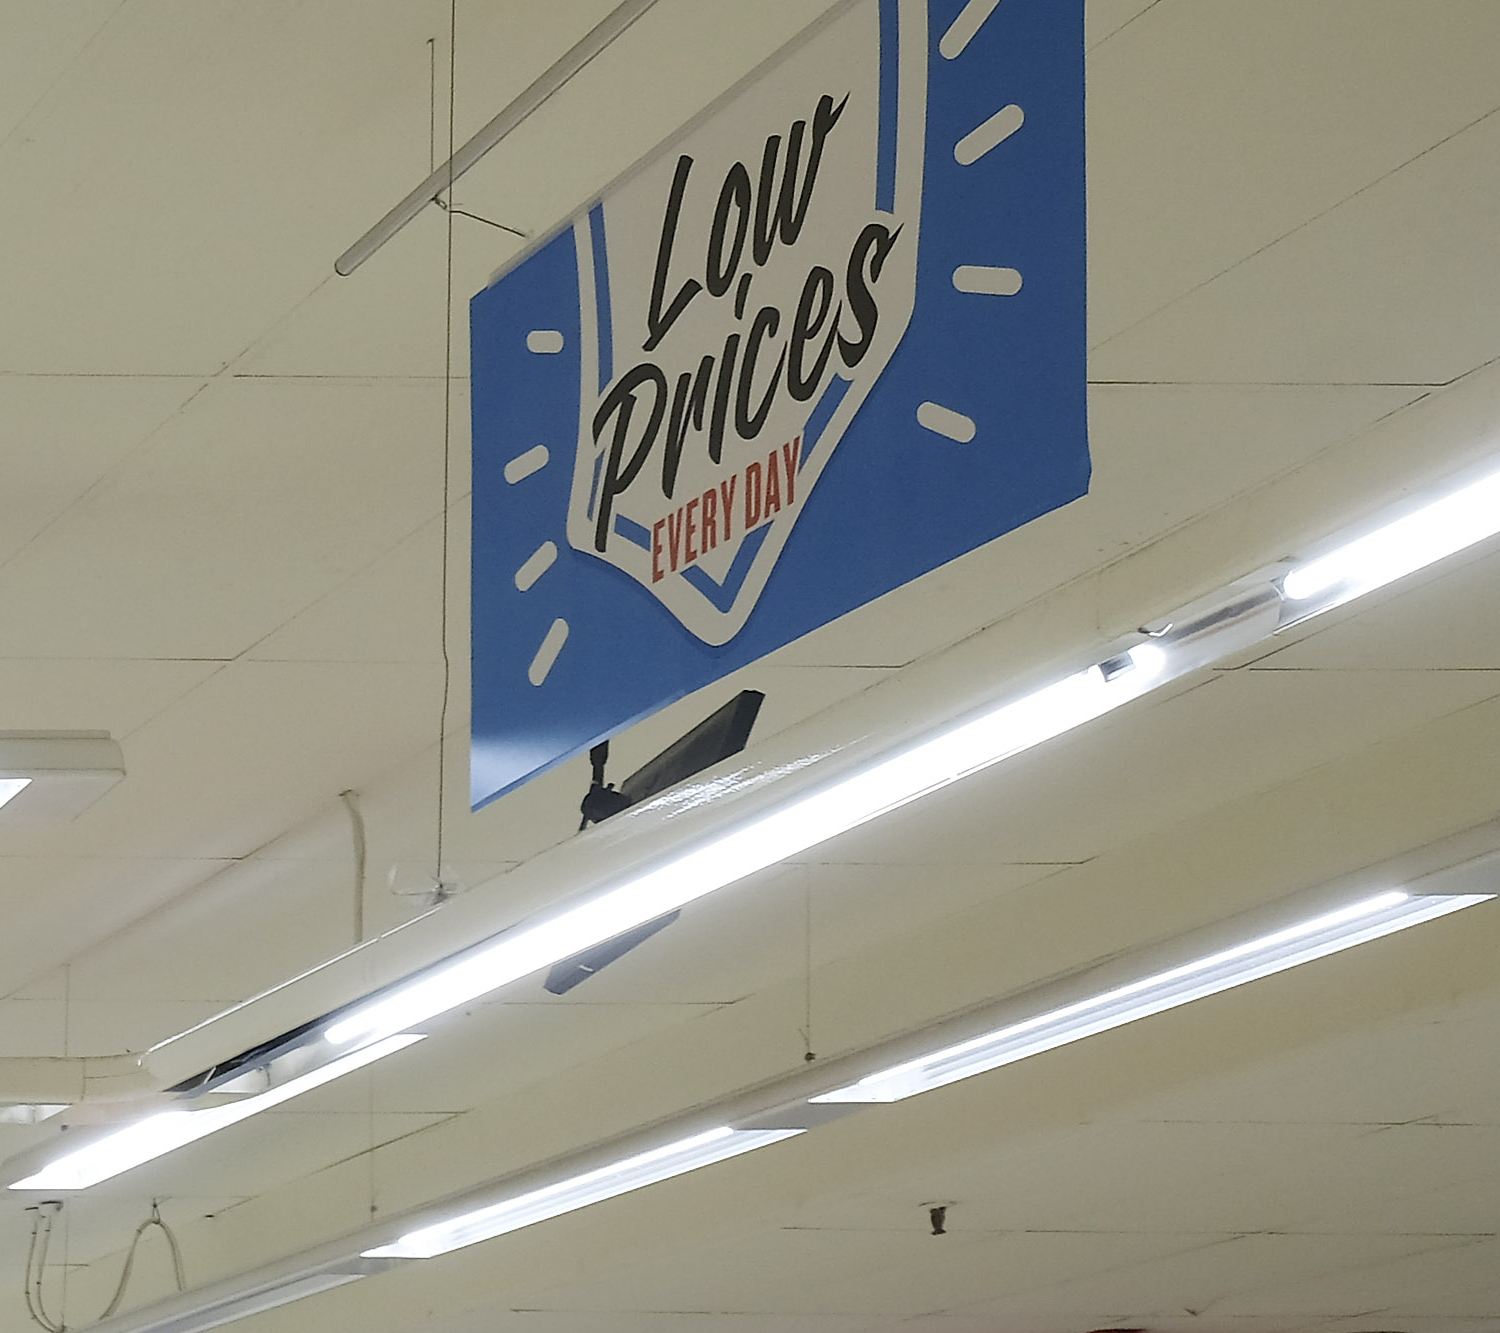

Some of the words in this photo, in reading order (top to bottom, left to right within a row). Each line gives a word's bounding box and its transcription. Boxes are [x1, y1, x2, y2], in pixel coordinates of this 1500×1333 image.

[646, 91, 849, 351] Low
[590, 222, 903, 552] Prices
[650, 467, 738, 584] EVERY
[742, 434, 806, 535] DAY
